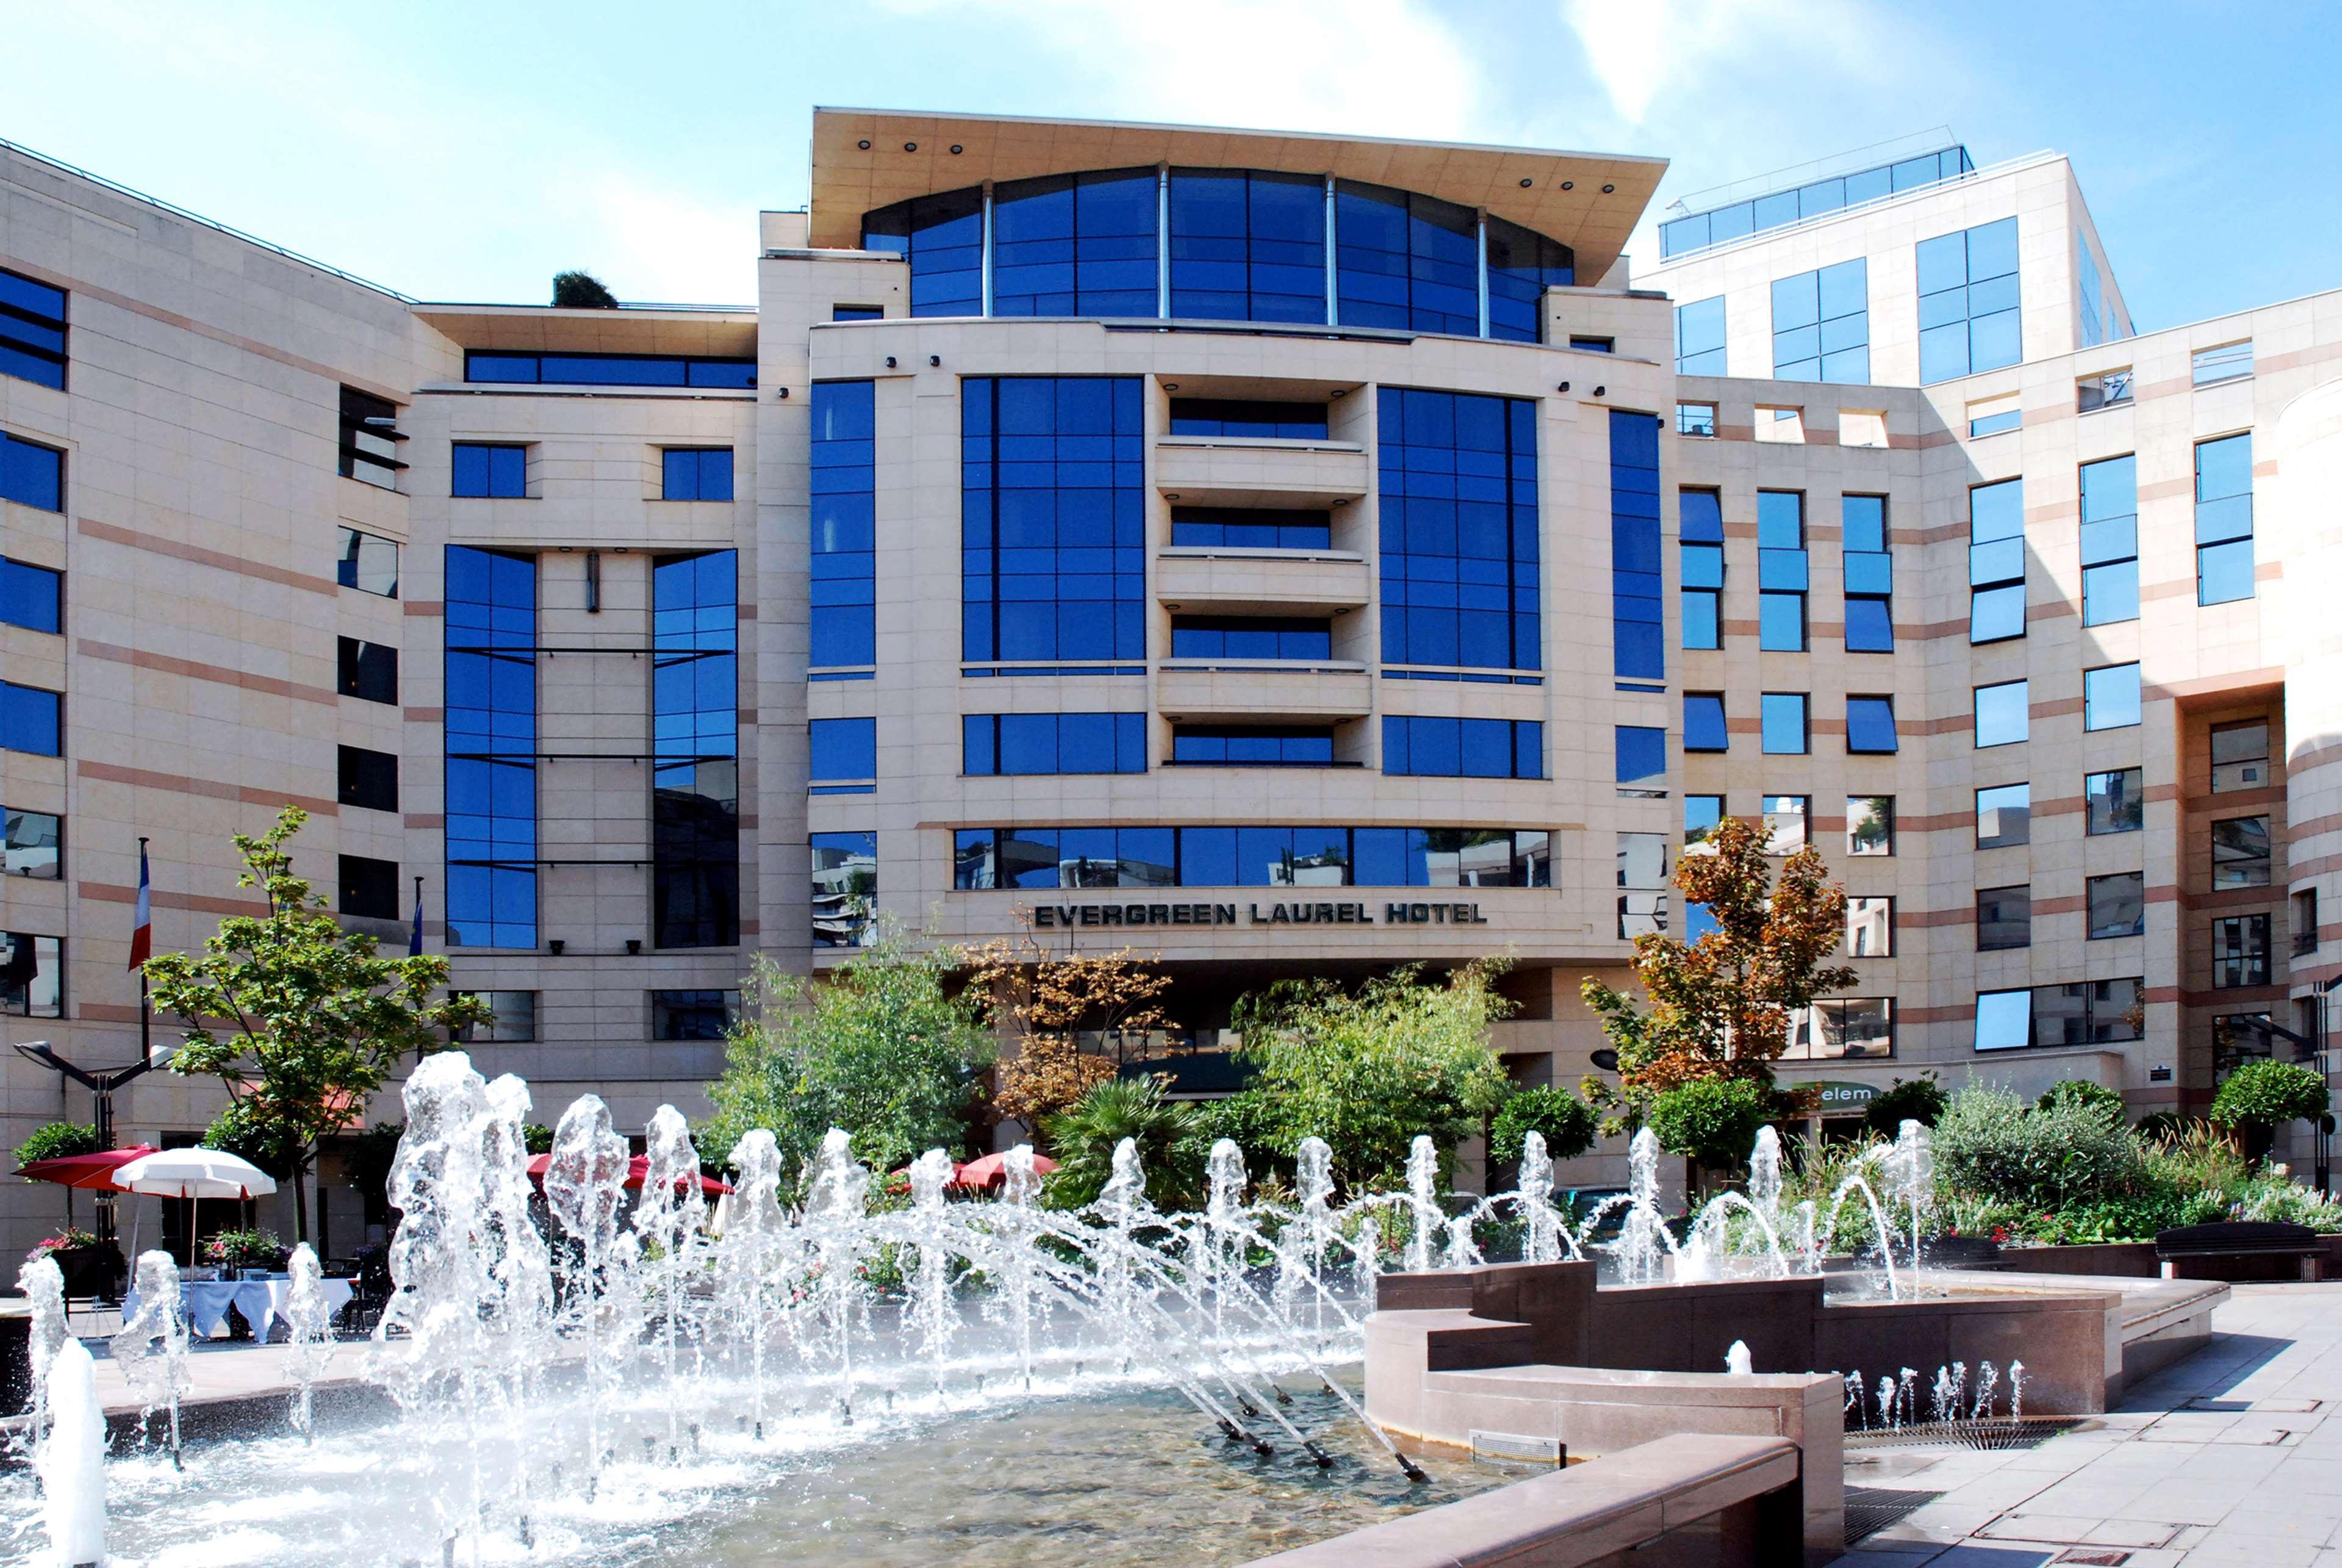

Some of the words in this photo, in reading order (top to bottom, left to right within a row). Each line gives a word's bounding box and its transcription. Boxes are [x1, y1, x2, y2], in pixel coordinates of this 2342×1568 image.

[1034, 903, 1237, 927] EVERGREEN
[1249, 903, 1374, 924] LAUREL
[1385, 902, 1488, 924] HOTEL
[1821, 1087, 1872, 1101] elem
